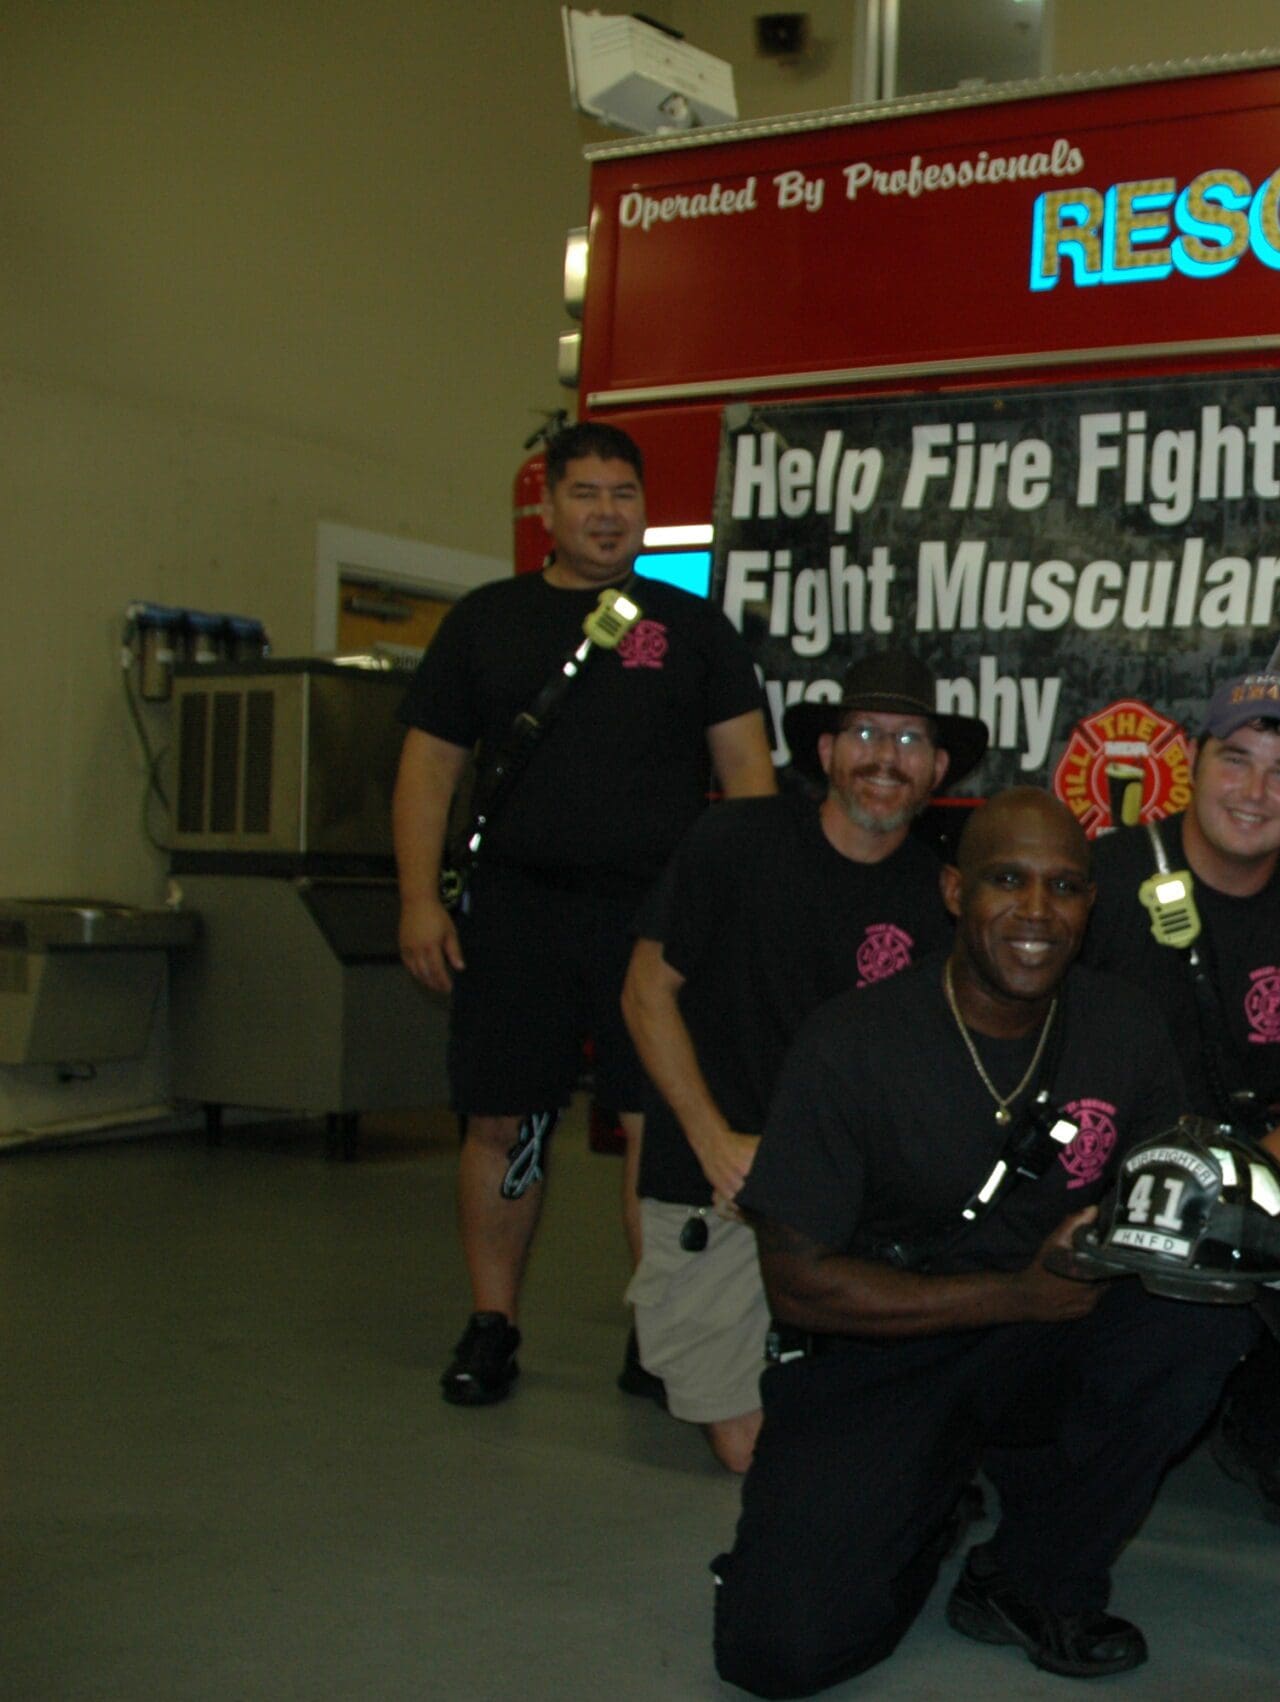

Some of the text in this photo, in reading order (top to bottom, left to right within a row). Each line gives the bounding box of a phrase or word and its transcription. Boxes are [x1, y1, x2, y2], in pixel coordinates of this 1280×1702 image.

[619, 138, 1084, 231] Operated By Professionals
[731, 429, 883, 534] Help
[902, 422, 1052, 512] Fire
[724, 545, 895, 657] Fight
[1097, 713, 1155, 740] THE
[1127, 1174, 1184, 1230] 41
[1122, 1232, 1176, 1251] HNFD
